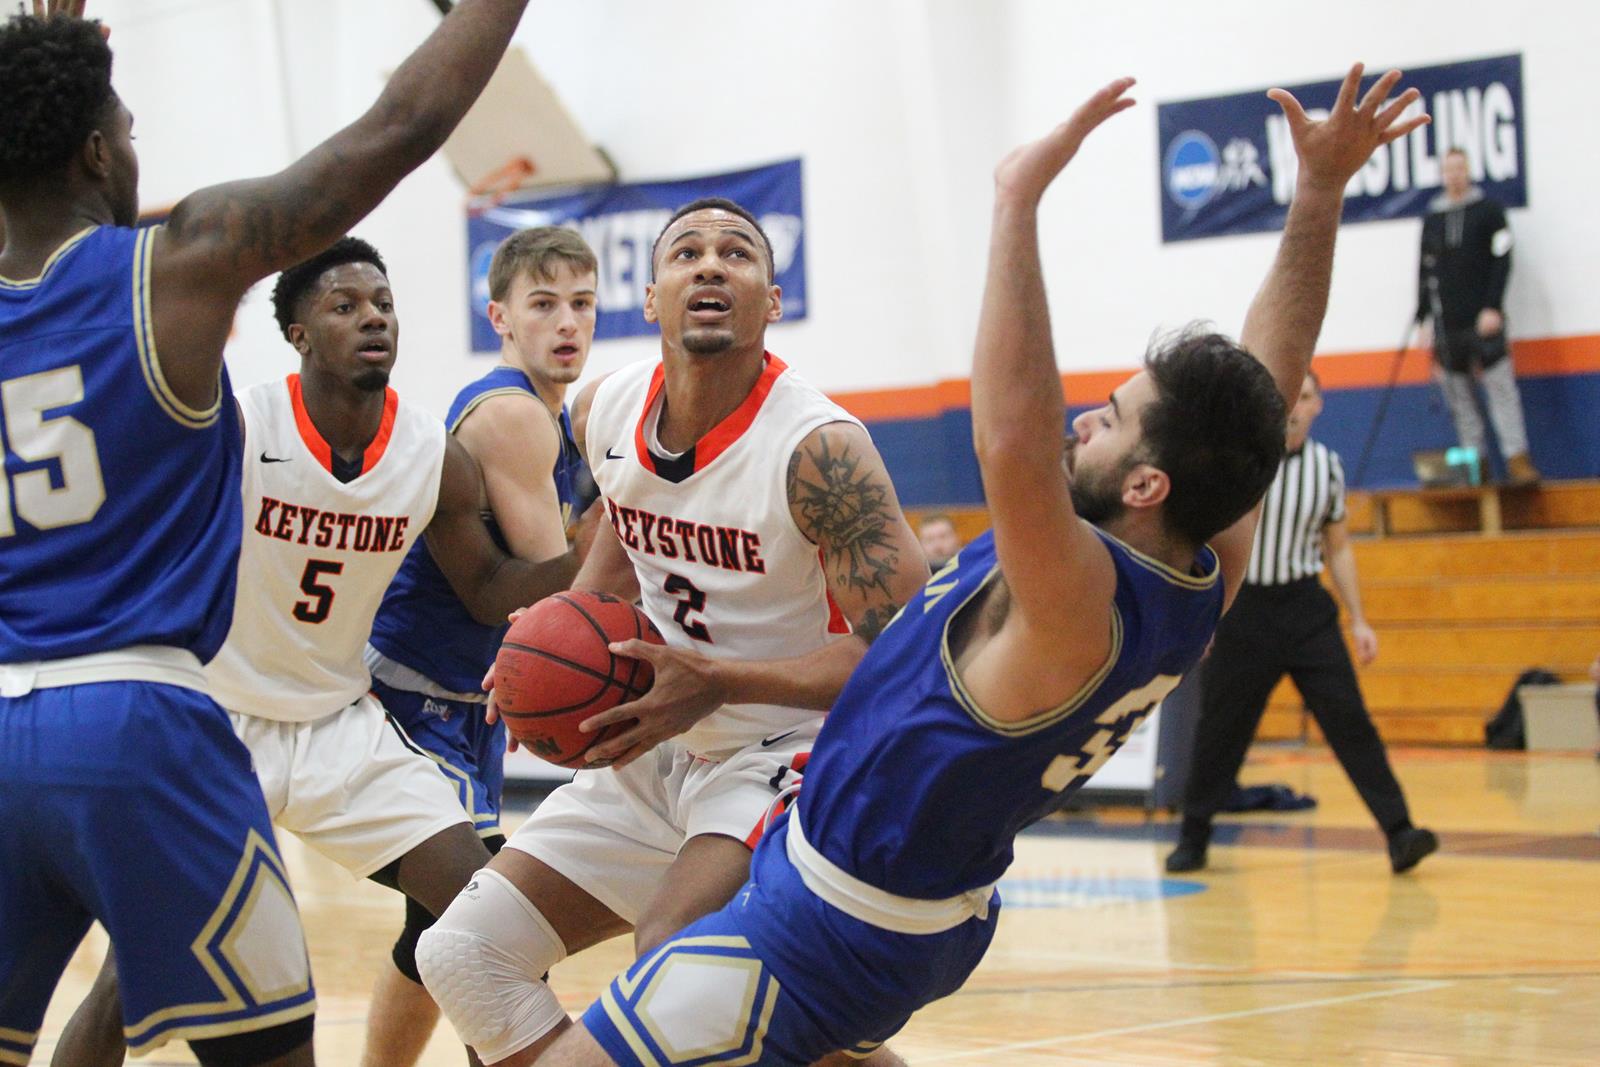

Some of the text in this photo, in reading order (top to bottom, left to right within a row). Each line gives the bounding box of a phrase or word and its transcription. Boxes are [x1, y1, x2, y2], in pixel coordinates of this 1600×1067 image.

[255, 496, 409, 553] KEYSTONE
[292, 558, 345, 625] 5
[663, 572, 714, 644] 2
